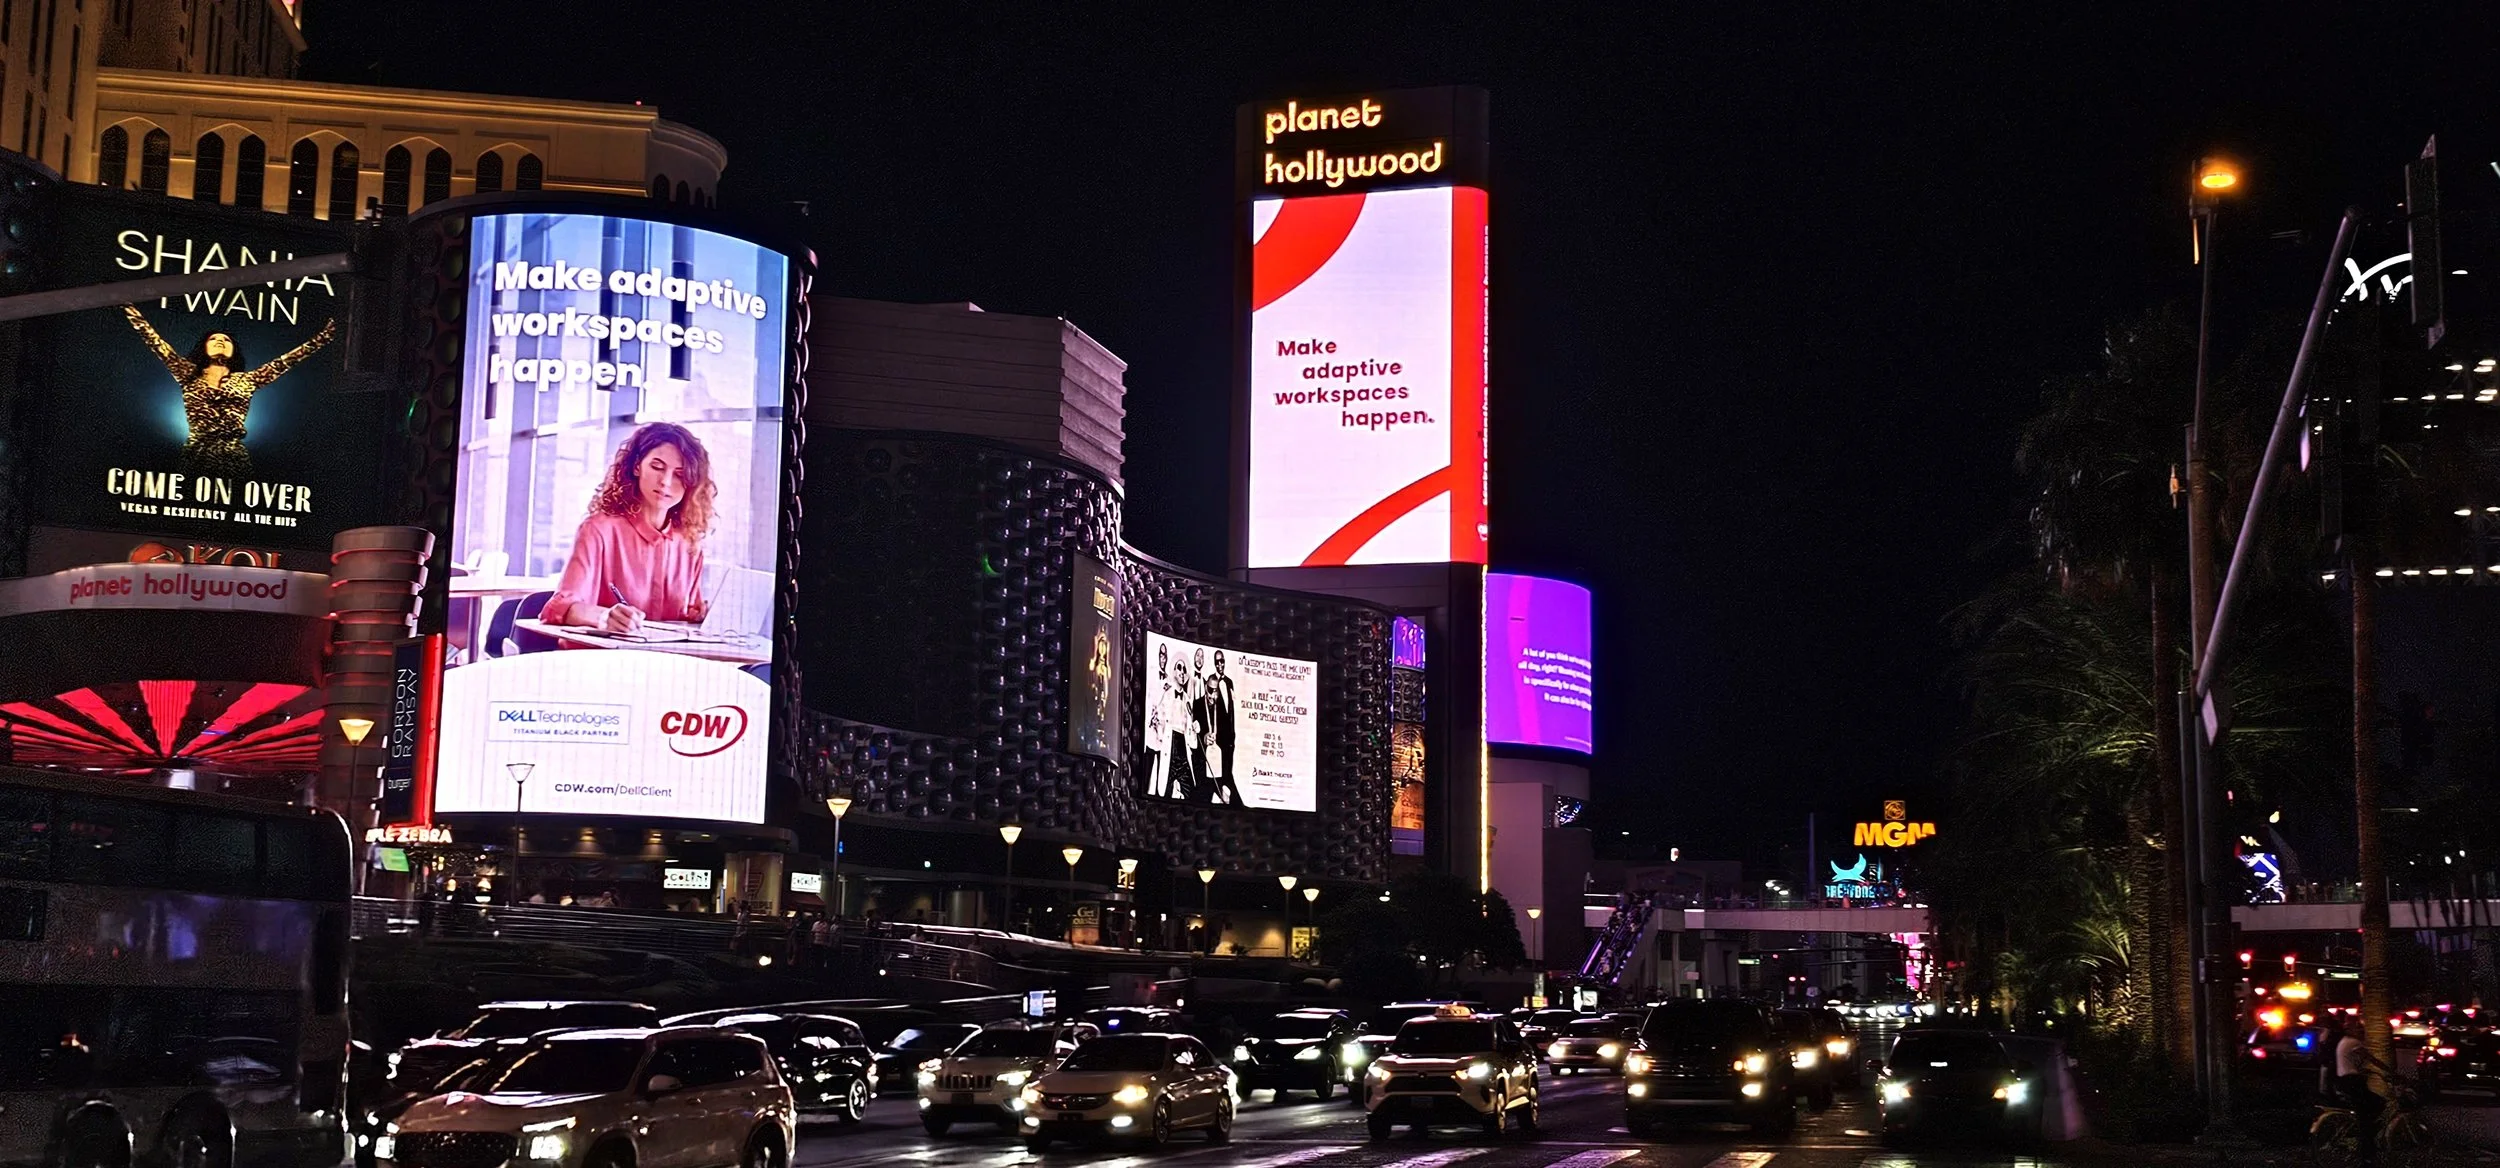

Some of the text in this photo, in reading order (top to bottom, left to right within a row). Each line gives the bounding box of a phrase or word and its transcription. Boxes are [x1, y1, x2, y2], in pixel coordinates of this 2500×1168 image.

[1265, 99, 1382, 144] planet
[1265, 142, 1442, 188] hollywood
[495, 260, 767, 320] Make adaptive
[492, 307, 724, 354] workspaces
[1277, 338, 1337, 356] Make
[489, 351, 651, 392] happen.
[1302, 358, 1403, 383] adaptive
[1274, 386, 1410, 408] workspaces
[1342, 410, 1435, 431] happen.
[107, 467, 312, 513] COME ON OVER
[120, 501, 297, 528] VEGAS RESIDENCY ALL THE HITS
[70, 573, 288, 604] planet hollywood
[392, 669, 408, 758] GORDON
[402, 668, 417, 757] RAMSAY
[498, 710, 620, 727] DELL Technologies
[660, 711, 731, 739] CDW
[397, 828, 453, 843] ZEBRA
[1853, 821, 1936, 848] MGM
